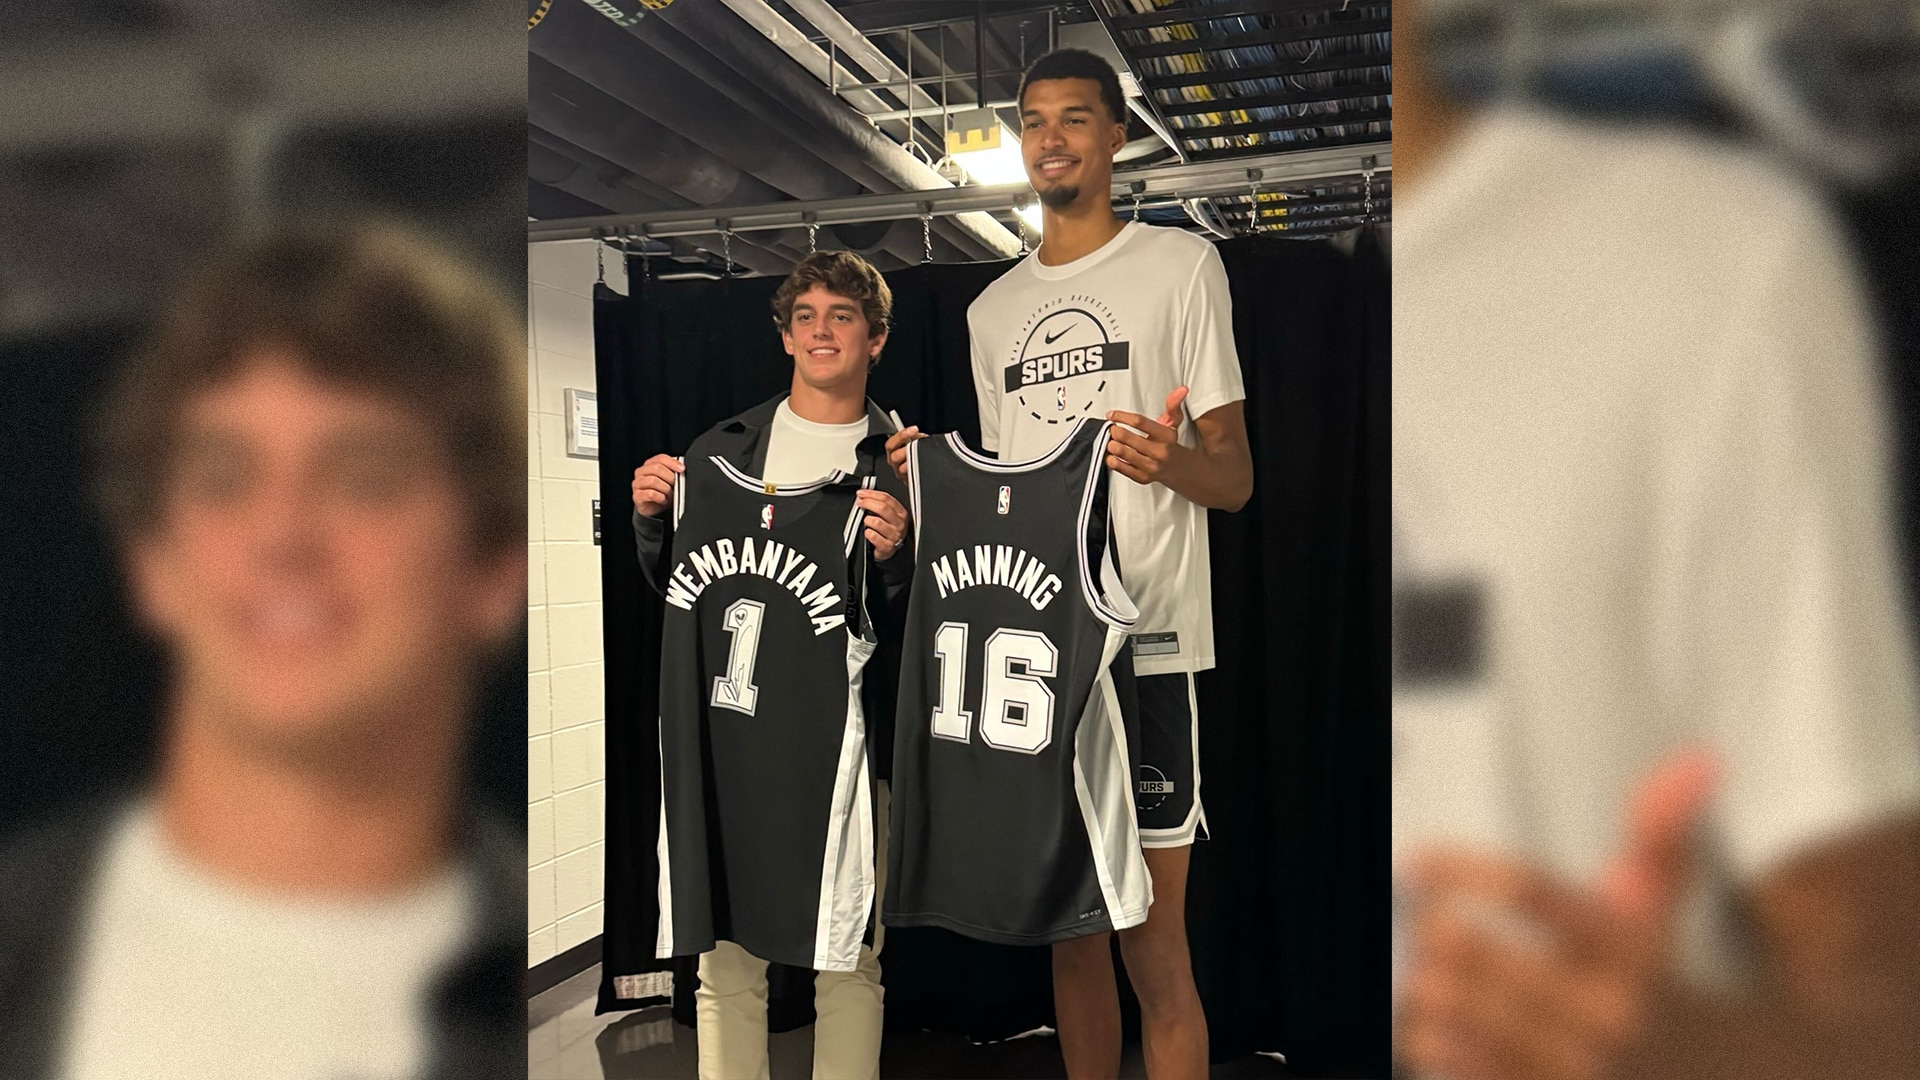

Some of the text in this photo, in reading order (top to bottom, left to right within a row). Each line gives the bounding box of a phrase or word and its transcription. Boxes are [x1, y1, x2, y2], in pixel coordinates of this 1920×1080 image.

[1021, 345, 1104, 385] SPURS
[665, 536, 846, 636] WEMBANYAMA
[931, 544, 1063, 611] MANNING
[710, 597, 767, 717] 1
[931, 620, 1059, 756] 16
[1140, 782, 1164, 792] URS
